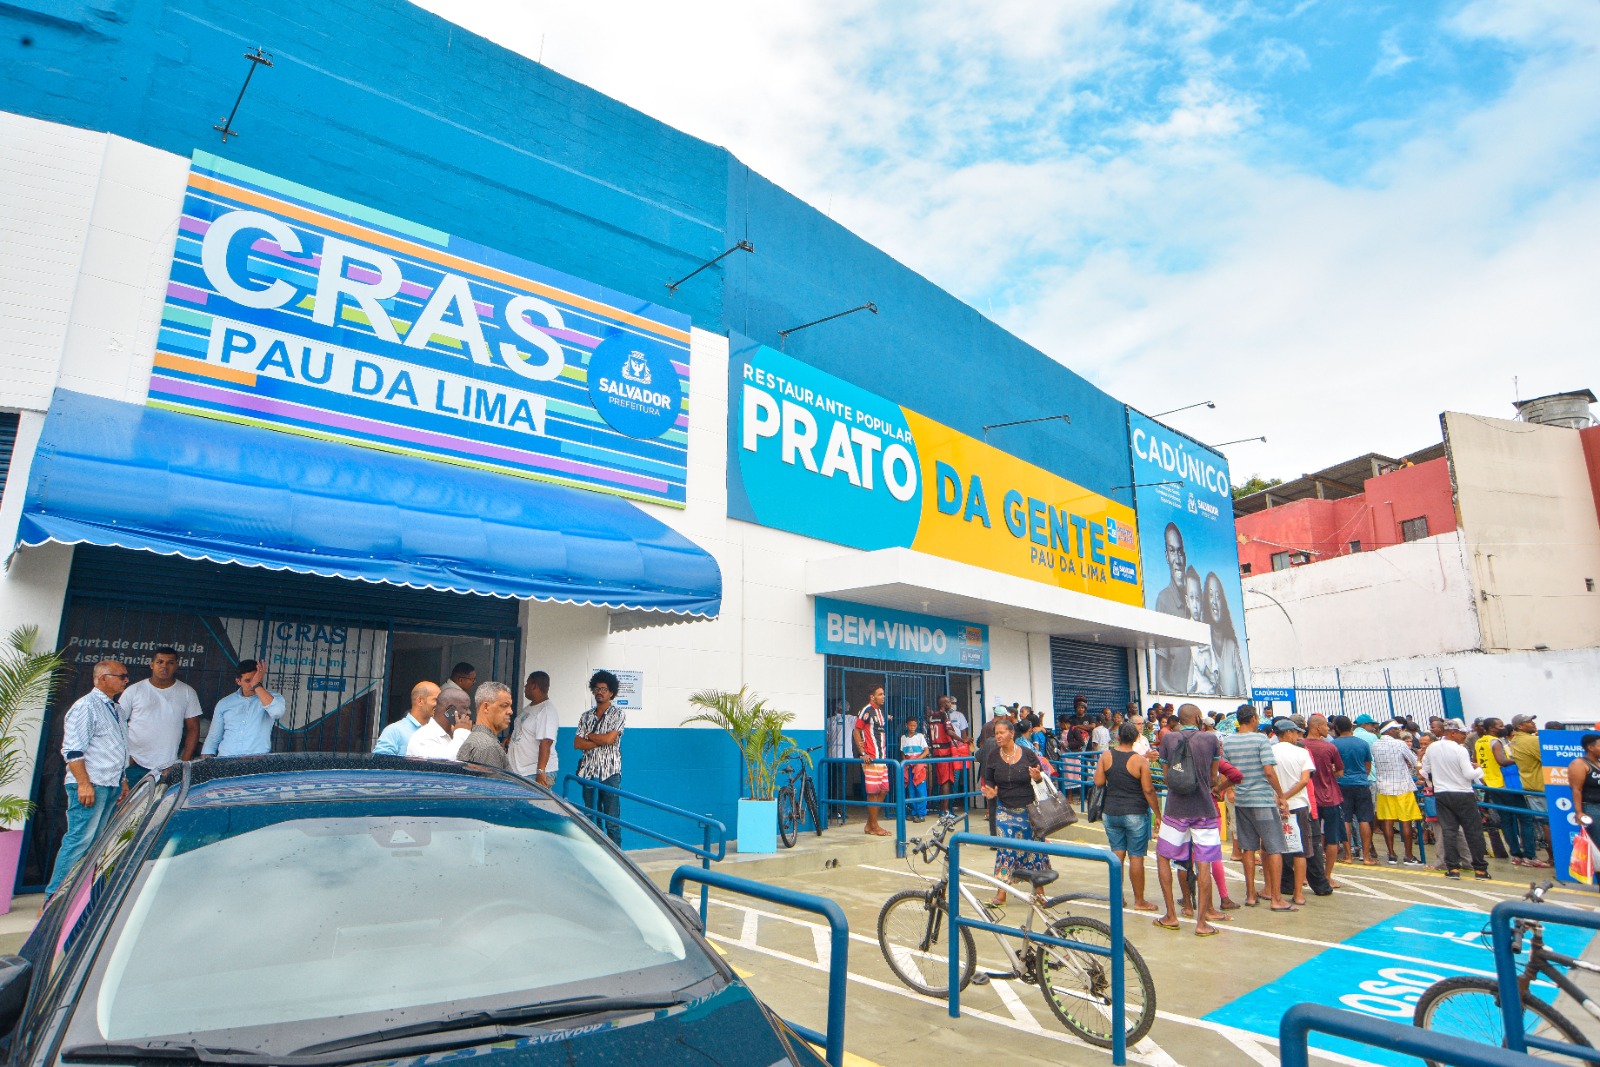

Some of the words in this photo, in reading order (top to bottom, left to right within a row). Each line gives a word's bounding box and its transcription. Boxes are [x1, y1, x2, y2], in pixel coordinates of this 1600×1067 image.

[201, 210, 566, 382] CRAS
[220, 327, 335, 385] PAU
[351, 359, 419, 406] DA
[435, 379, 537, 432] LIMA
[599, 377, 672, 410] SALVADOR
[608, 396, 661, 417] PREFEITURA
[743, 363, 853, 421] RESTAURANTE
[856, 410, 913, 446] POPULAR
[743, 384, 917, 502] PRATO
[1133, 427, 1229, 498] CADÚNICO
[936, 460, 992, 528] DA
[1003, 489, 1107, 565] GENTE
[1030, 546, 1055, 569] PAU
[1059, 555, 1077, 575] DA
[1080, 561, 1108, 584] LIMA
[69, 636, 110, 649] Porta
[112, 638, 130, 650] de
[188, 643, 205, 654] da
[276, 622, 347, 645] CRAS
[827, 612, 947, 655] BEM-VINDO
[273, 653, 298, 666] Pau
[1254, 688, 1285, 697] CADÚNICO
[1542, 744, 1586, 752] RESTAUR
